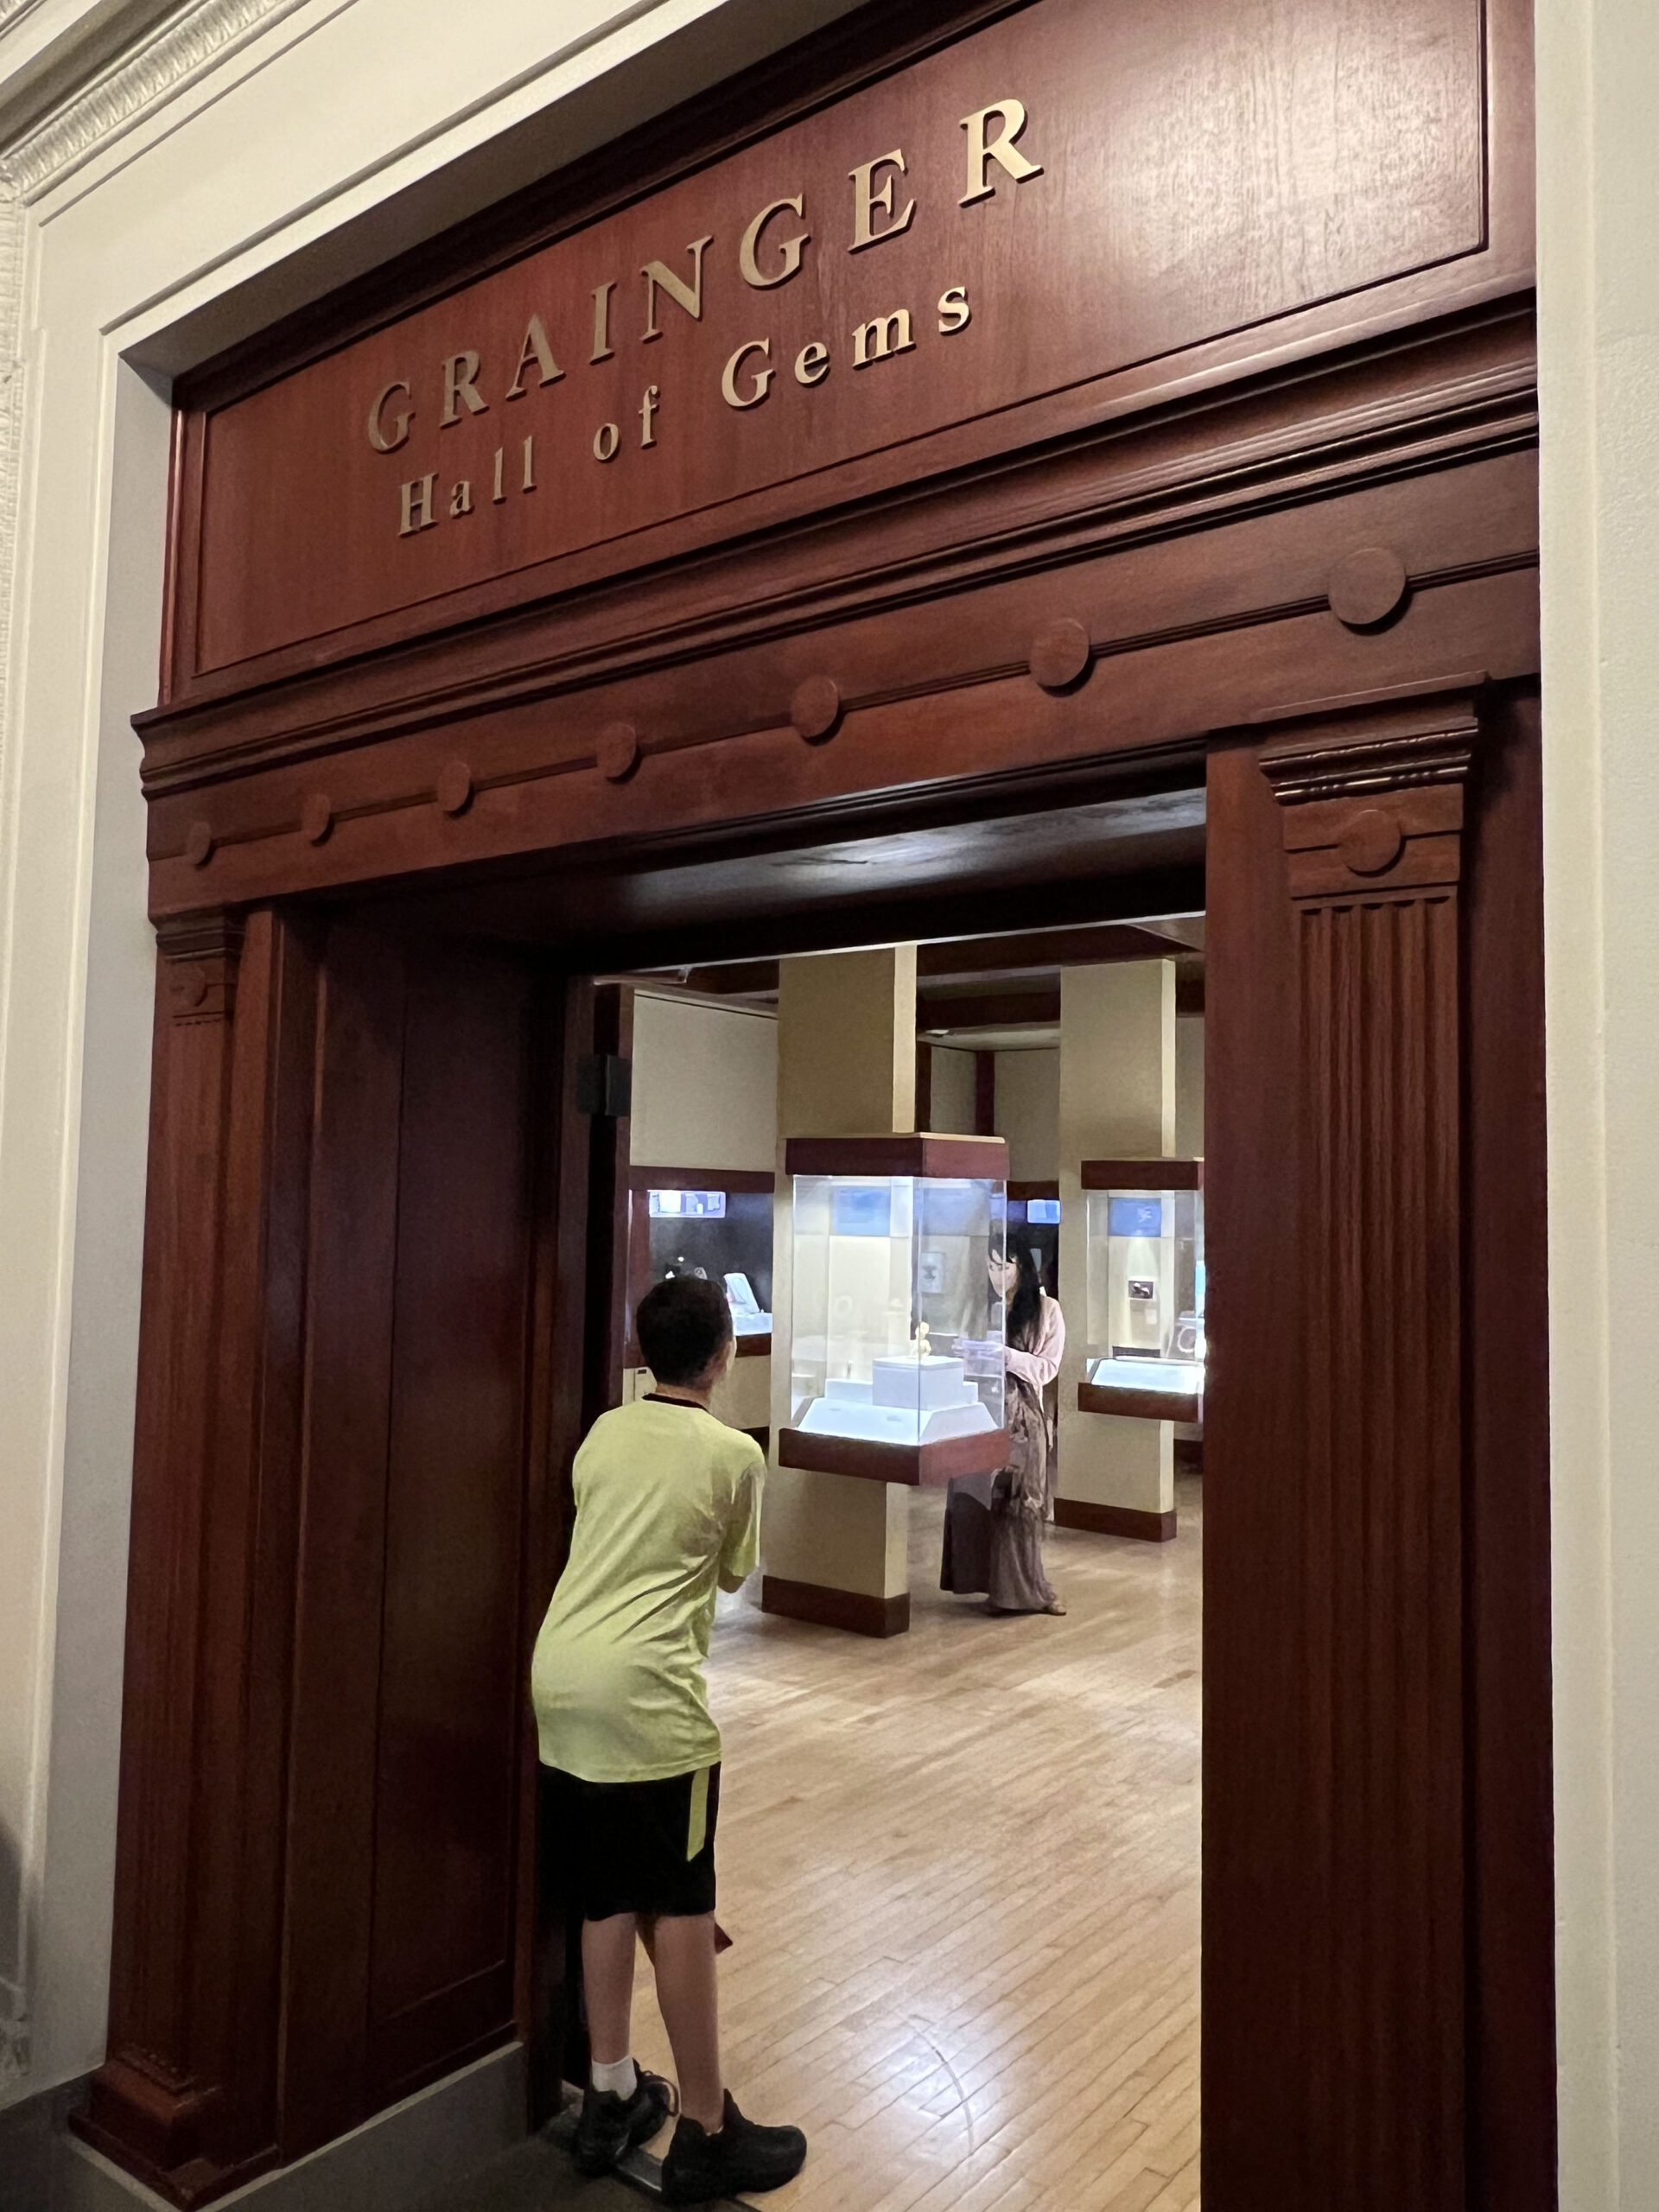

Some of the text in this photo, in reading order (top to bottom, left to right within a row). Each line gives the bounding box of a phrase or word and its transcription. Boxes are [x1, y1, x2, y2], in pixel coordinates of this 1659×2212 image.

[367, 99, 1042, 453] GRAINGER
[398, 287, 971, 537] Hall of Gems
